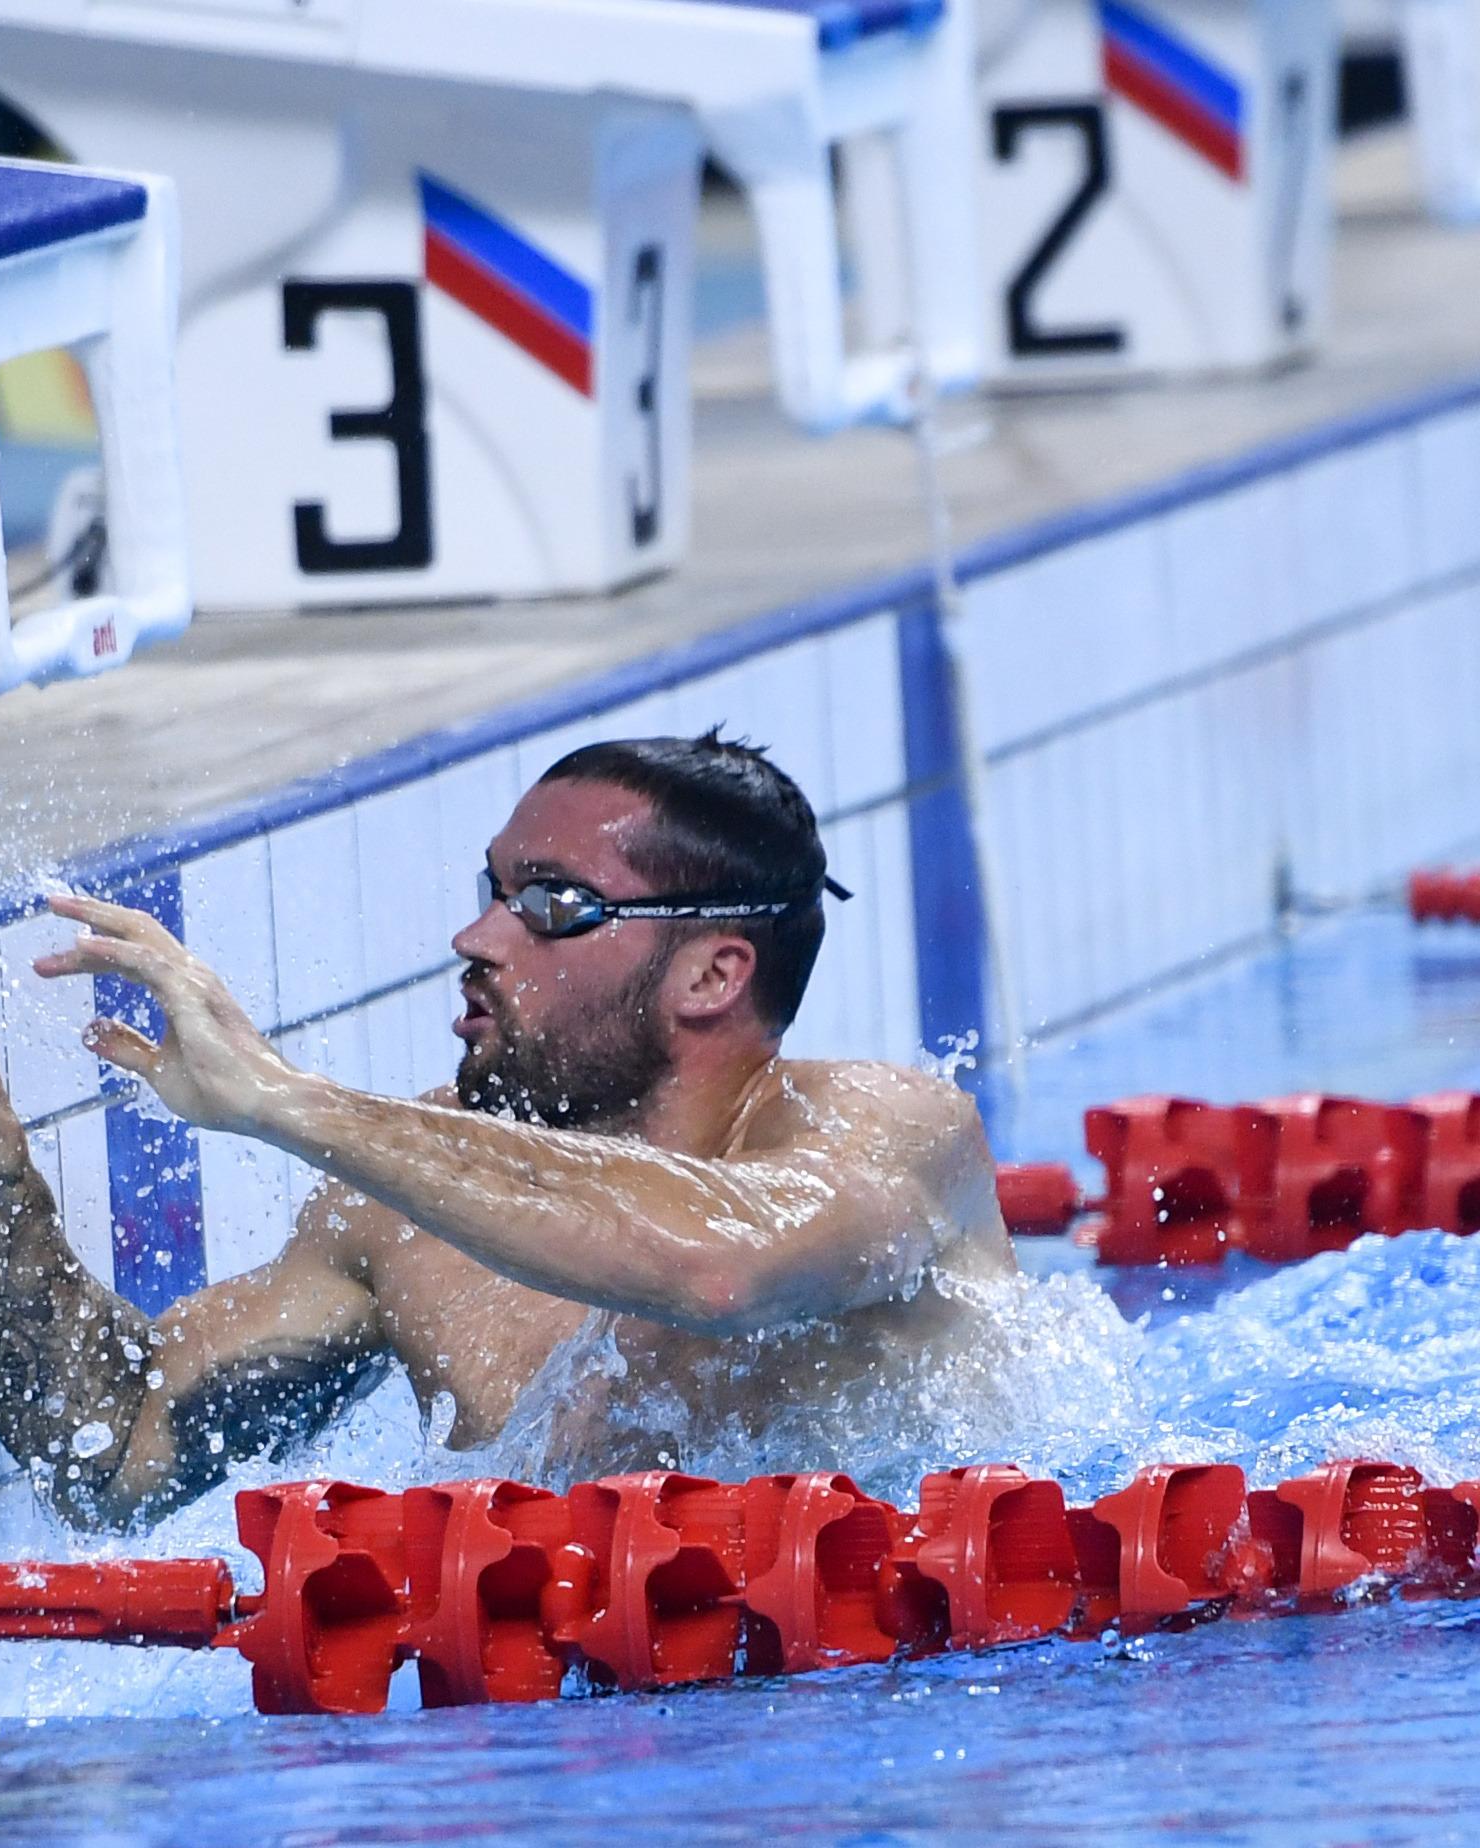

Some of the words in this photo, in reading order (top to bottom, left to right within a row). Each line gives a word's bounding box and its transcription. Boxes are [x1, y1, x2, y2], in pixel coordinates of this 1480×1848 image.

[992, 103, 1126, 357] 2
[283, 280, 434, 574] 3
[630, 242, 662, 547] 3
[618, 905, 673, 918] speedo
[699, 903, 751, 918] speedo
